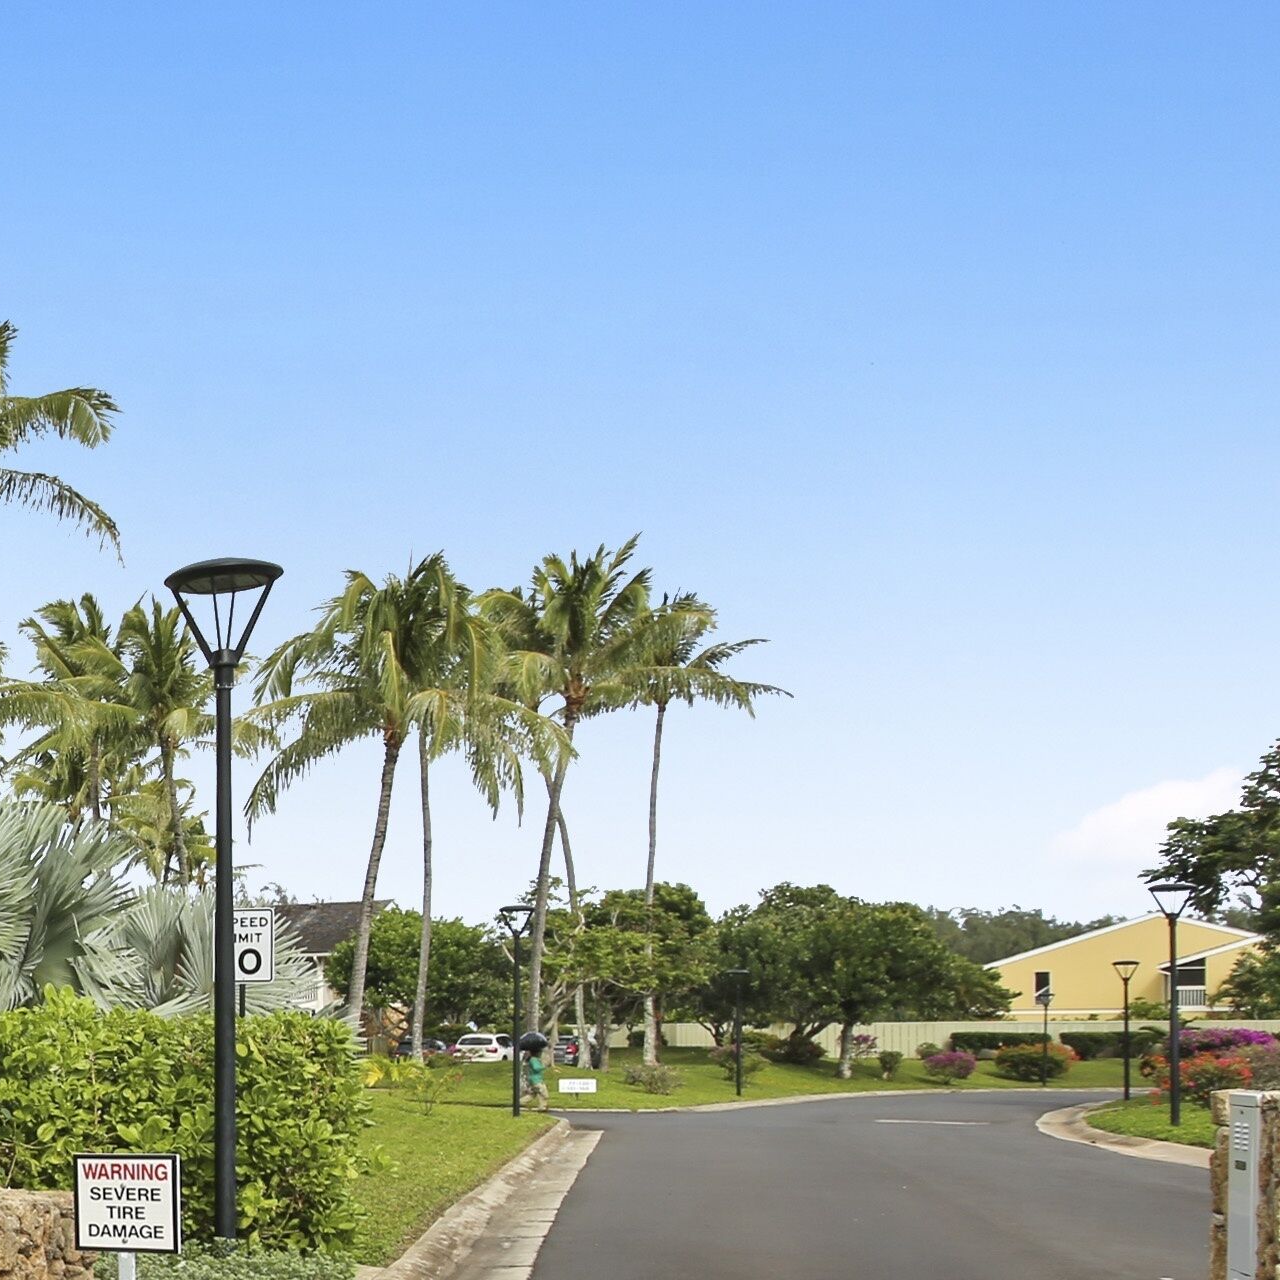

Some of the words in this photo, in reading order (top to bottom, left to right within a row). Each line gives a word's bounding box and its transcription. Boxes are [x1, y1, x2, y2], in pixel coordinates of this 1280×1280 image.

[233, 917, 268, 927] PEED
[233, 933, 262, 943] IMIT
[238, 948, 262, 975] 0
[82, 1163, 168, 1181] WARNING
[90, 1187, 161, 1201] SEVERE
[106, 1206, 145, 1219] TIRE
[88, 1224, 164, 1239] DAMAGE
